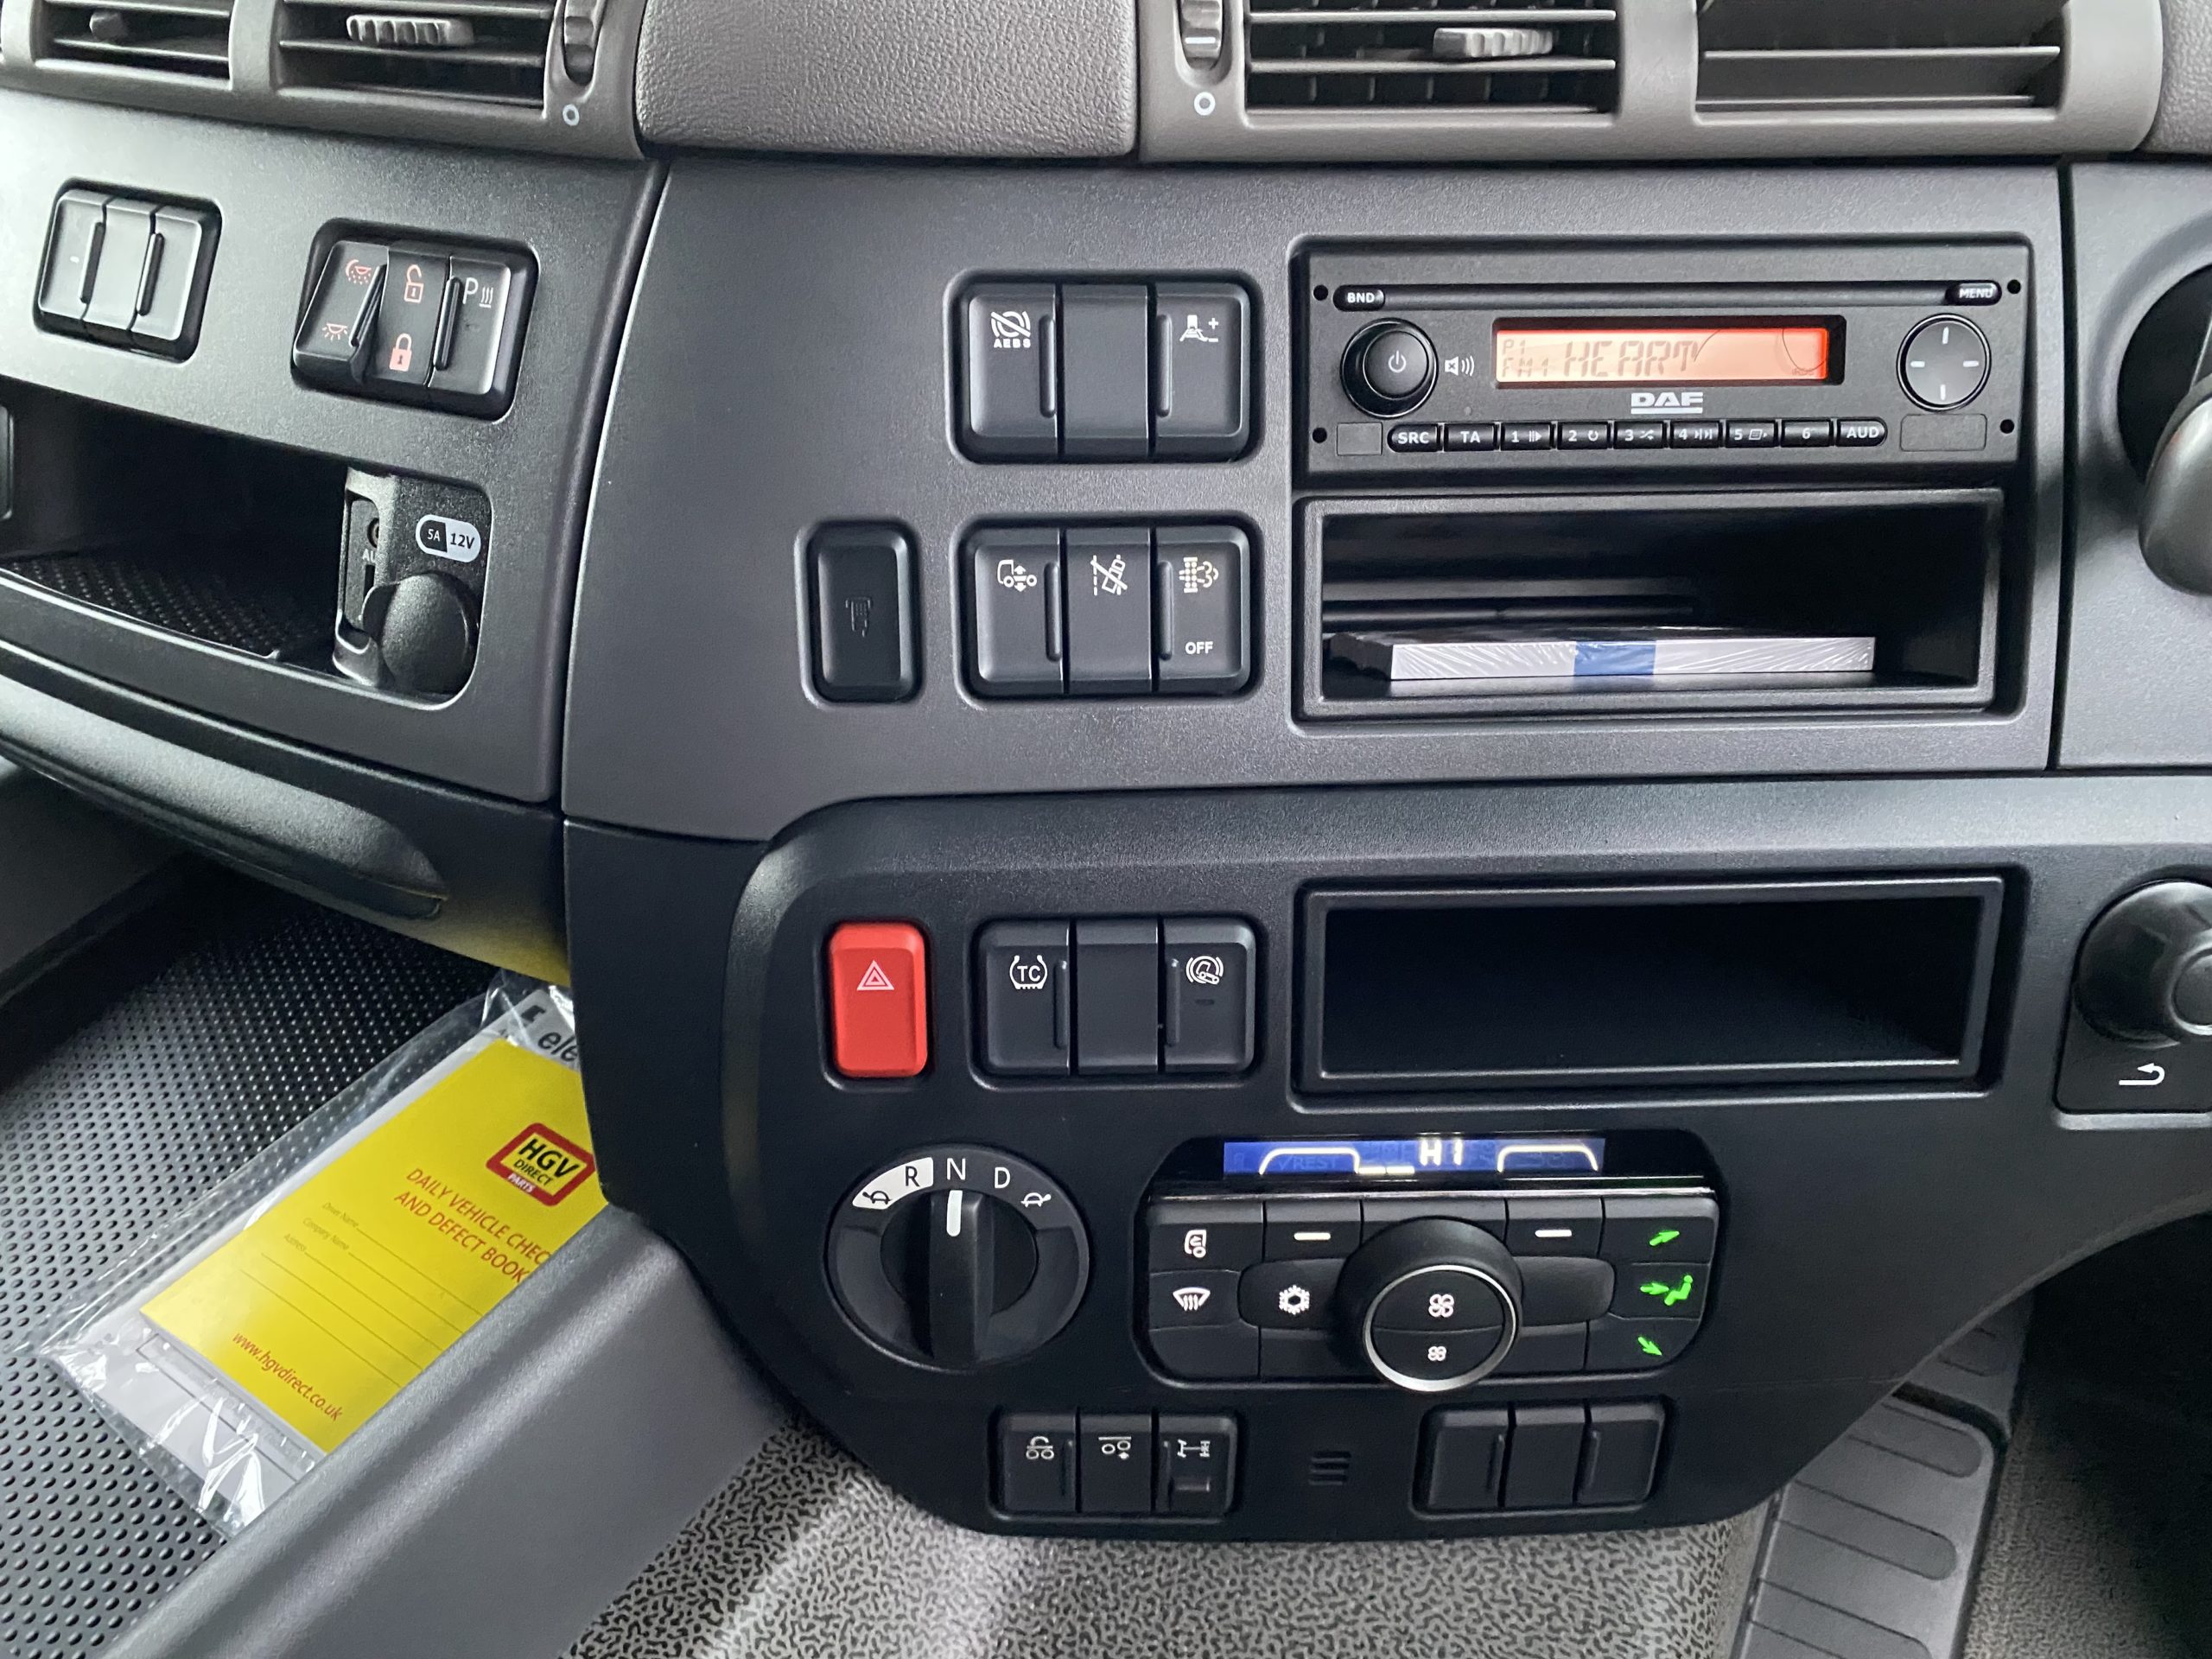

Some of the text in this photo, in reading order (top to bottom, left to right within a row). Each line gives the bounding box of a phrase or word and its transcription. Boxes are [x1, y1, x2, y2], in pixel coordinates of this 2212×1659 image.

[1347, 292, 1375, 303] BND
[1959, 288, 1993, 299] MENU
[993, 338, 1031, 348] AEBS
[1630, 391, 1704, 407] DAF
[1397, 430, 1430, 445] SRC
[1460, 430, 1481, 443] TA
[1511, 430, 1520, 443] 1
[1568, 429, 1578, 442] 2
[1624, 429, 1635, 442] 3
[1678, 428, 1687, 441] 4
[1733, 428, 1743, 441] 5
[1802, 427, 1811, 440] 6
[1846, 426, 1880, 439] AUD
[427, 528, 441, 542] 5A
[450, 533, 475, 550] 12V
[1185, 640, 1214, 655] OFF
[1016, 965, 1041, 982] TC
[518, 1138, 580, 1179] HGV
[1418, 1138, 1463, 1166] HI
[513, 1159, 554, 1186] DIRECT
[946, 1157, 966, 1180] N
[507, 1173, 537, 1193] PARTS
[905, 1166, 920, 1187] R
[995, 1166, 1011, 1189] D
[406, 1167, 551, 1265] DAILY VEHICLE CHEC
[394, 1191, 531, 1283] AND DEFECT BOOK
[232, 1332, 343, 1421] www.hgvdirect.co.uk
